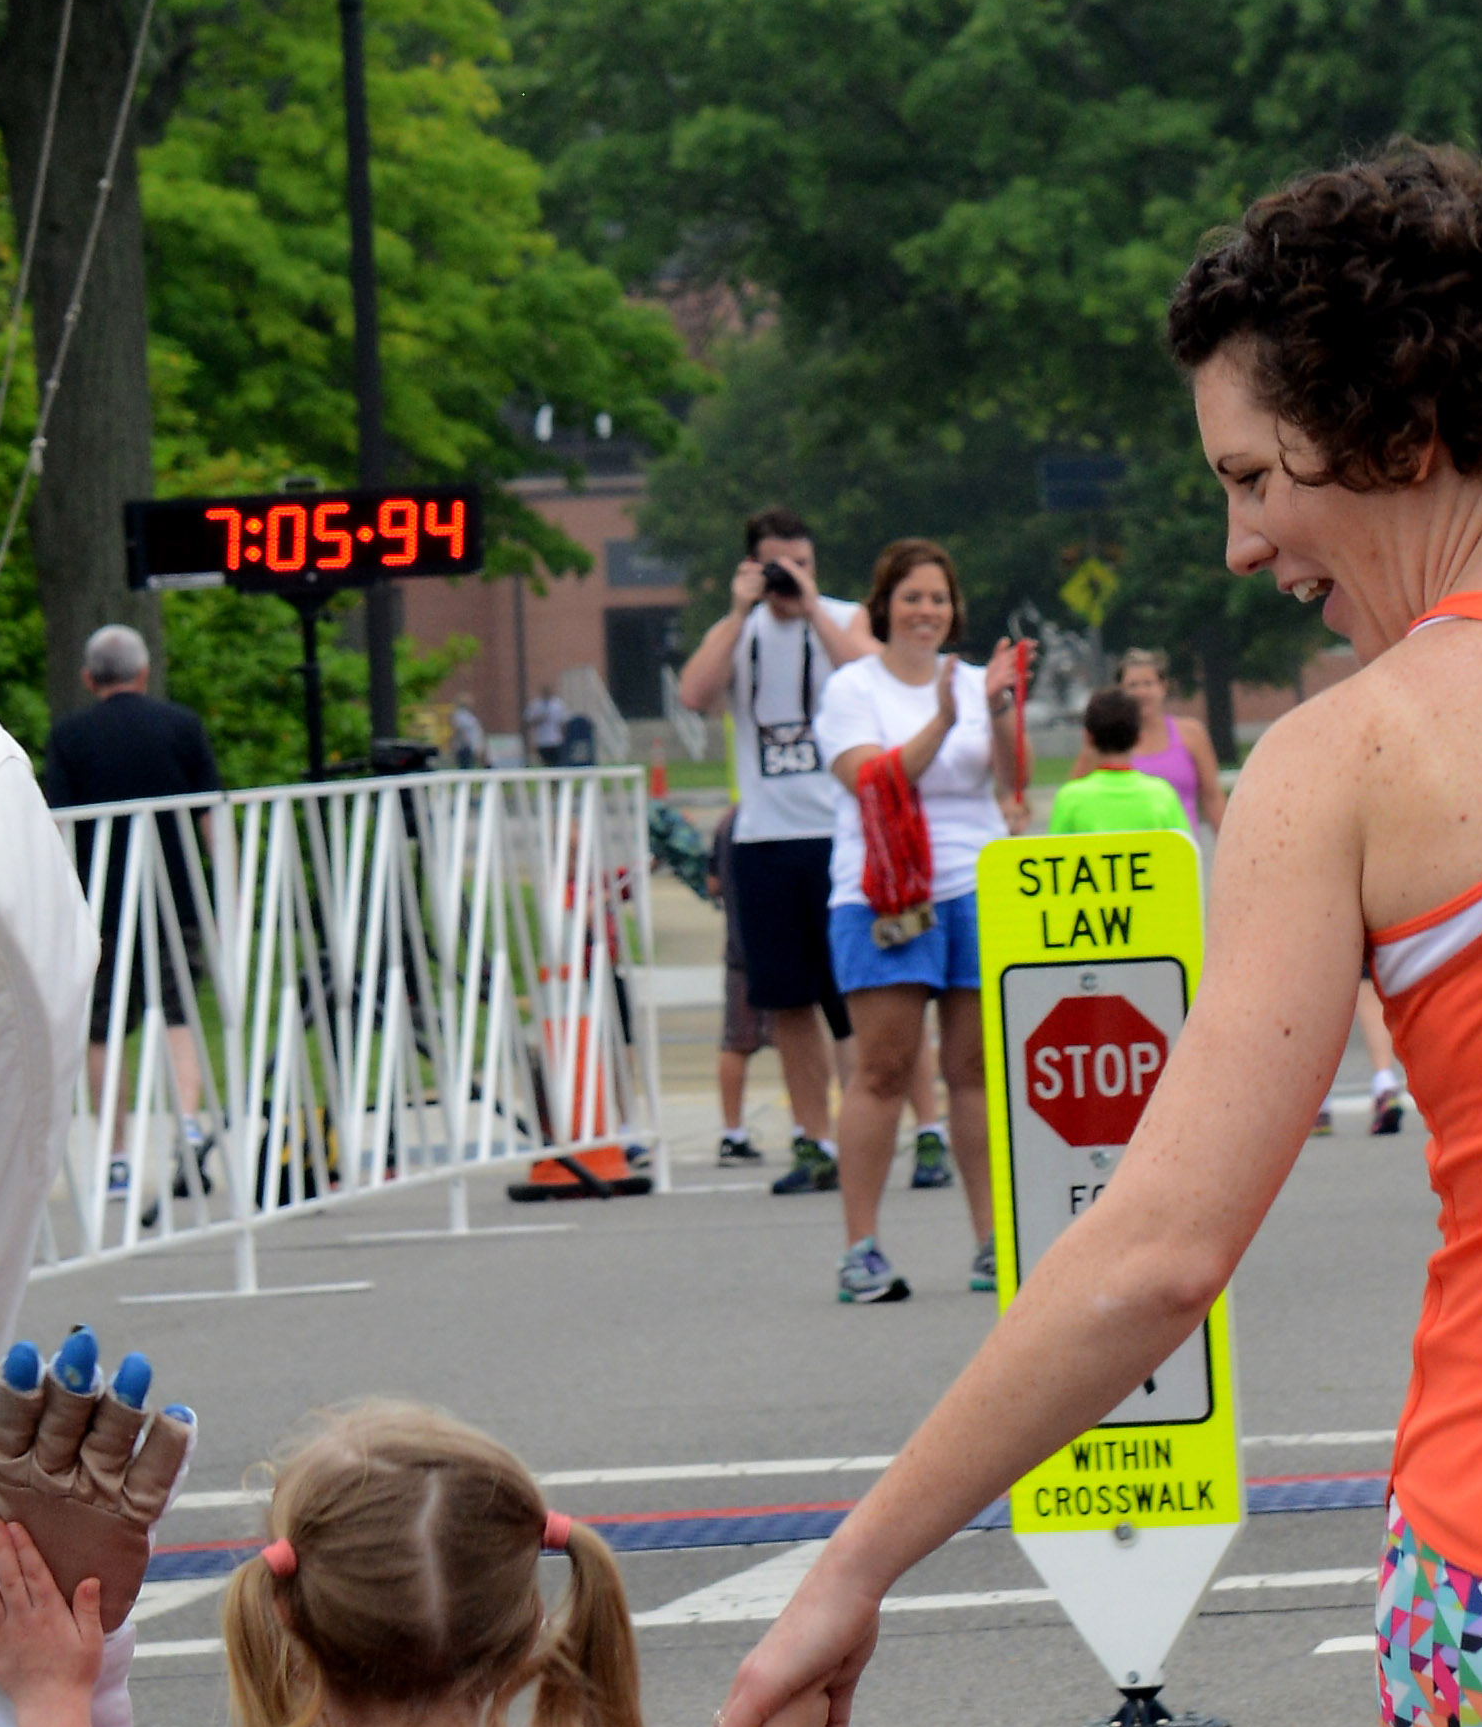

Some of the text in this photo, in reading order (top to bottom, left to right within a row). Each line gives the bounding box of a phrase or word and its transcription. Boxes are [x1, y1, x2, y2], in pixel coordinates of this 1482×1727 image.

[1019, 852, 1154, 896] STATE
[1041, 906, 1132, 948] LAW
[1033, 1042, 1161, 1101] STOP
[1071, 1438, 1173, 1472] WITHIN
[1035, 1480, 1215, 1517] CROSSWALK
